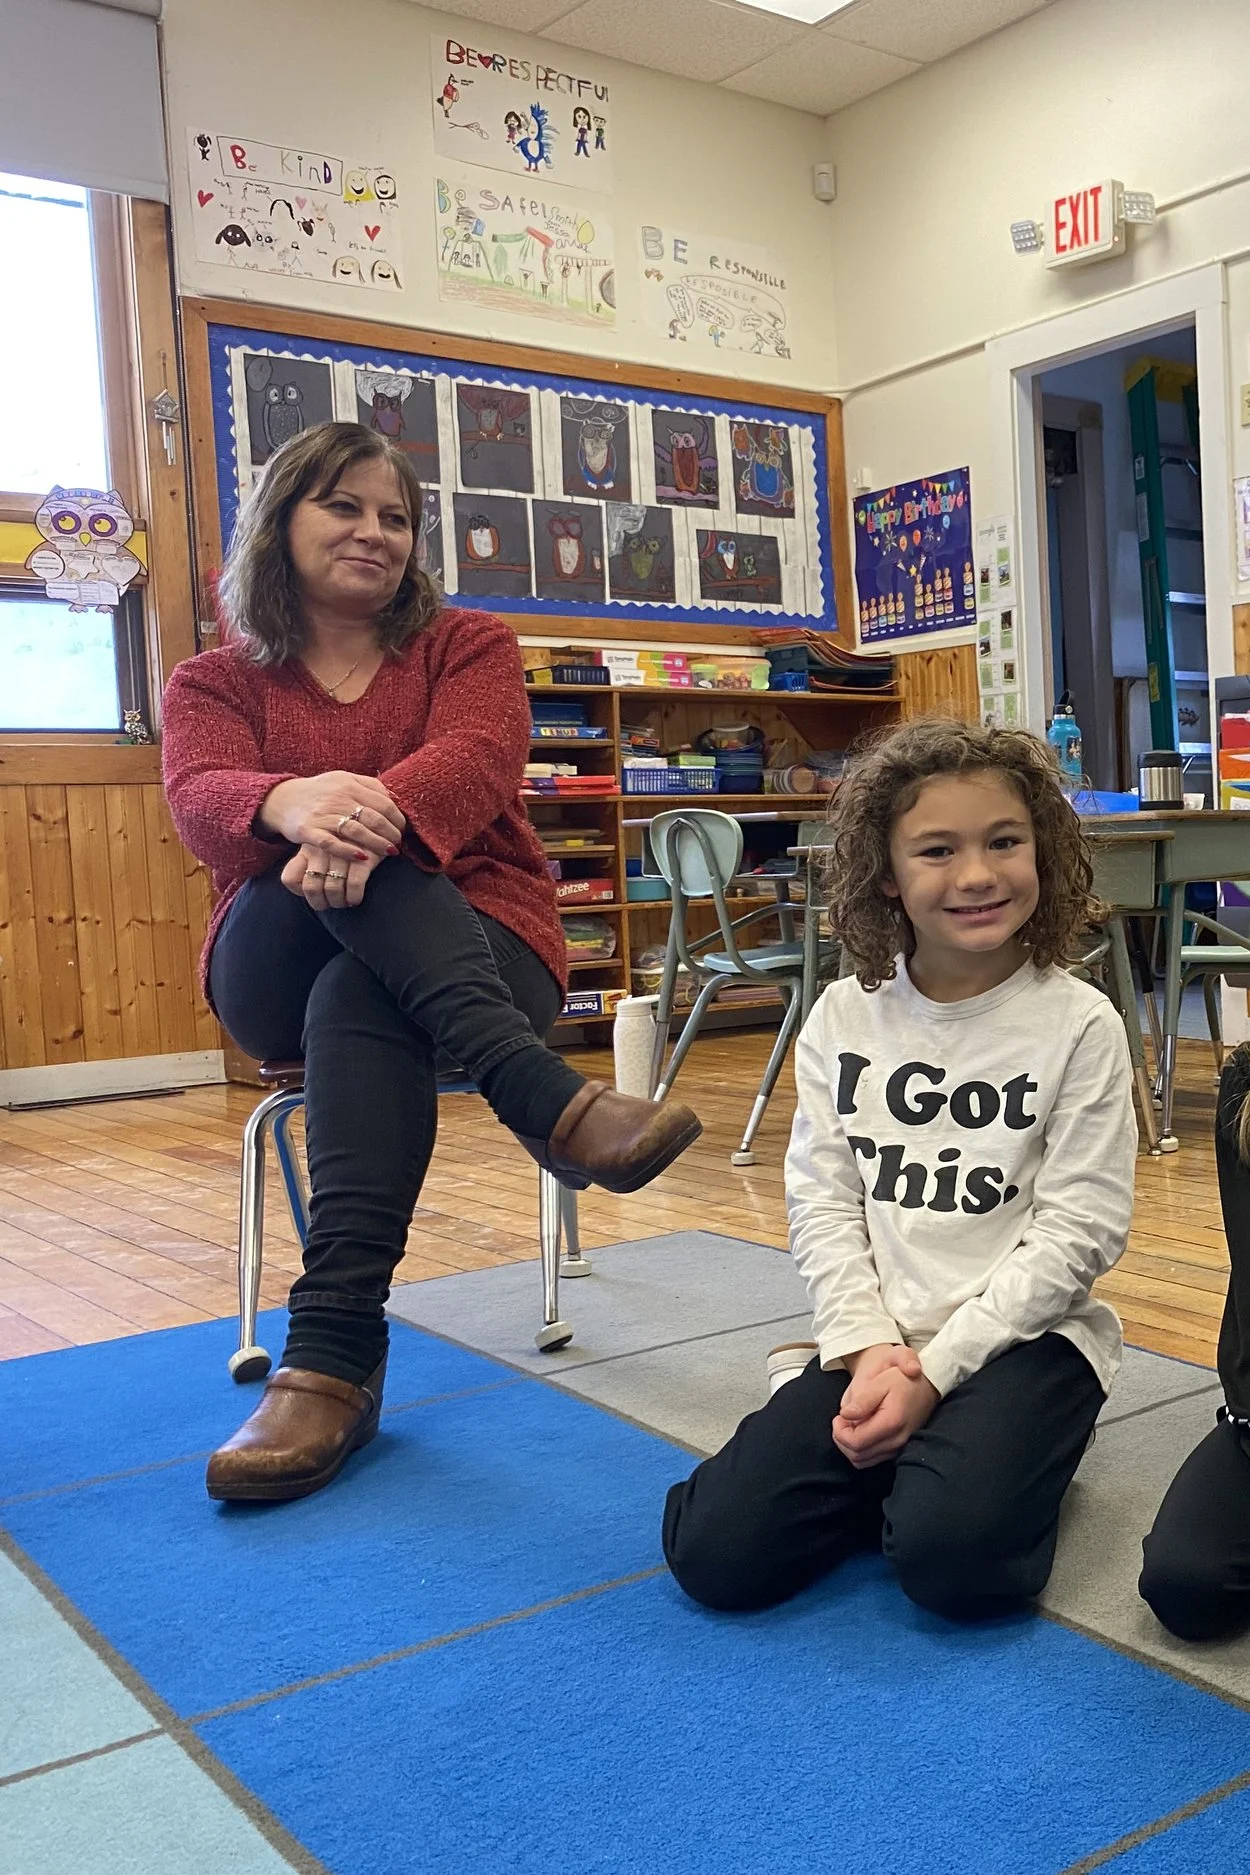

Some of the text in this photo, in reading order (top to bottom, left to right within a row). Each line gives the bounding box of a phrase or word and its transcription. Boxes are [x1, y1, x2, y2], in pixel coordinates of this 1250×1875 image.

[1055, 185, 1102, 254] EXIT
[867, 492, 957, 533] Happy Birthday
[570, 1001, 598, 1011] Factor
[837, 1052, 1038, 1130] I Got
